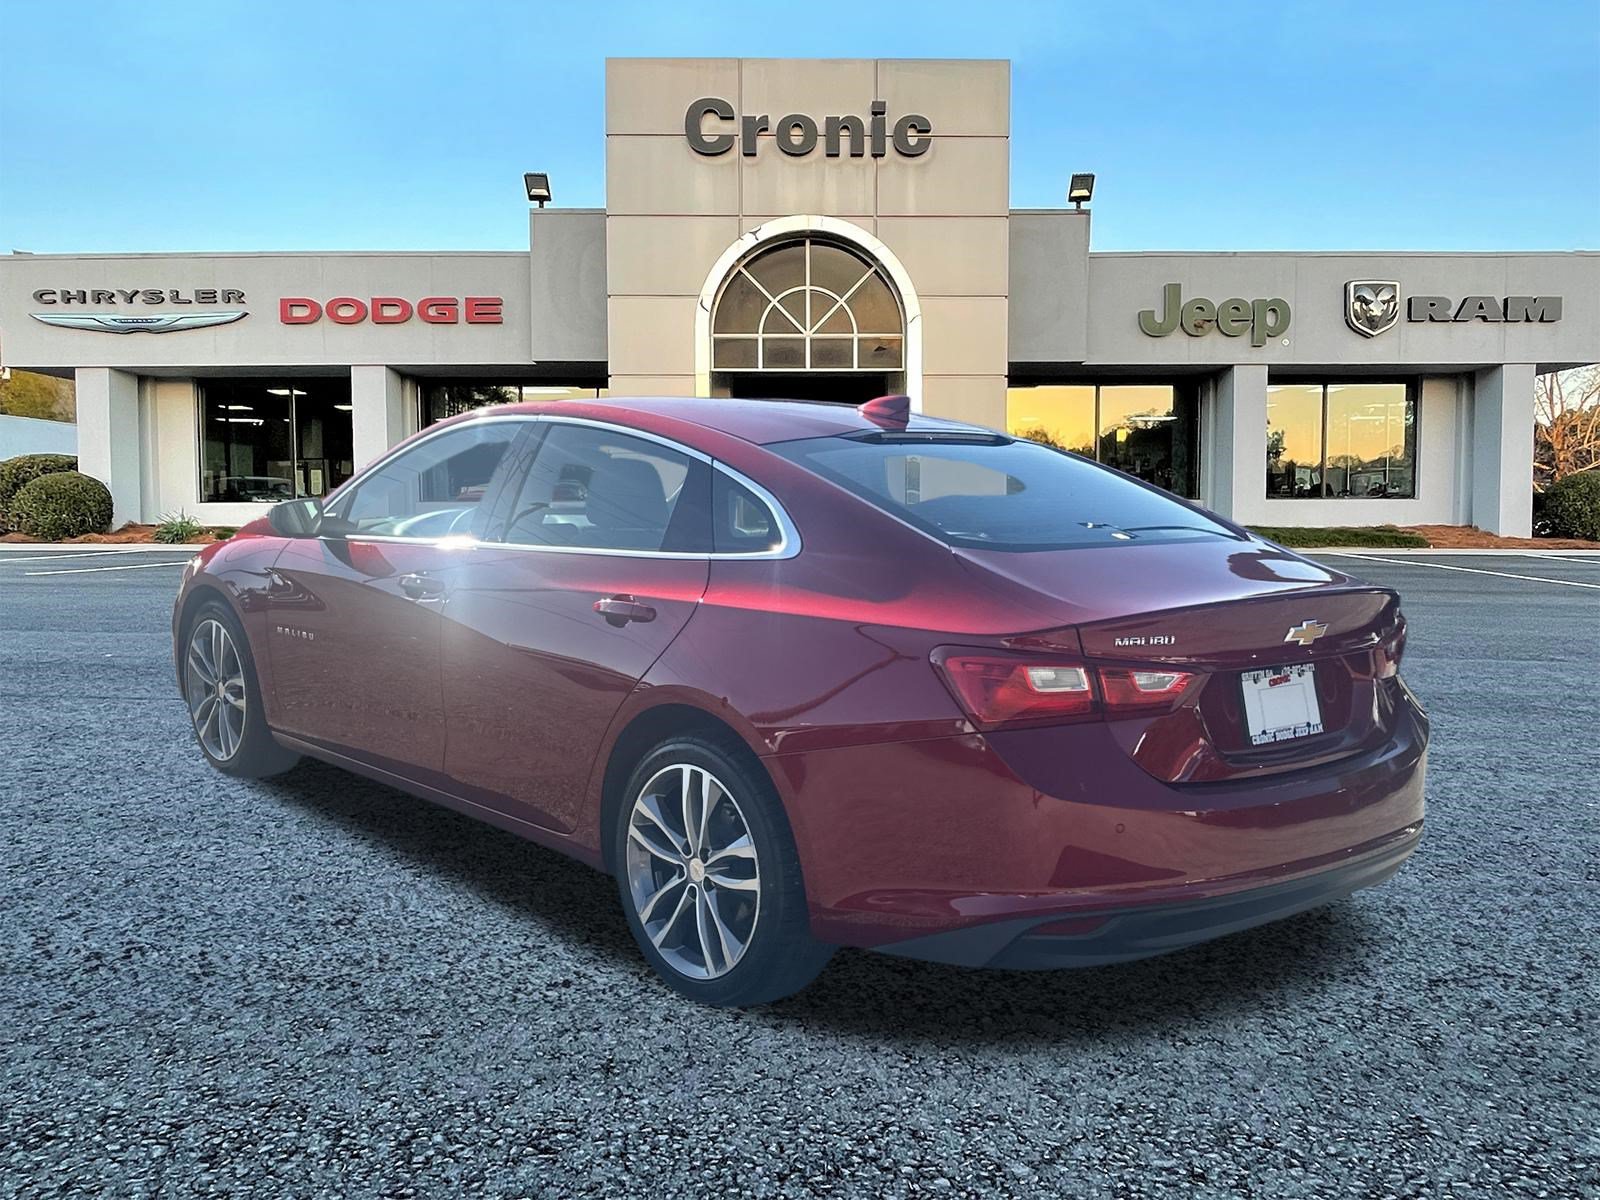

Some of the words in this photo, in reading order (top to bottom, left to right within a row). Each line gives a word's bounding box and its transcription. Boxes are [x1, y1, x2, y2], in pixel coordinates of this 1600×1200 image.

[685, 97, 932, 157] Cronic
[32, 289, 246, 304] CHRYSLER
[1407, 296, 1563, 322] RAM
[280, 297, 503, 324] DODGE
[1138, 283, 1291, 347] Jeep
[276, 626, 314, 640] MALIBU
[1115, 636, 1175, 646] MALIBU
